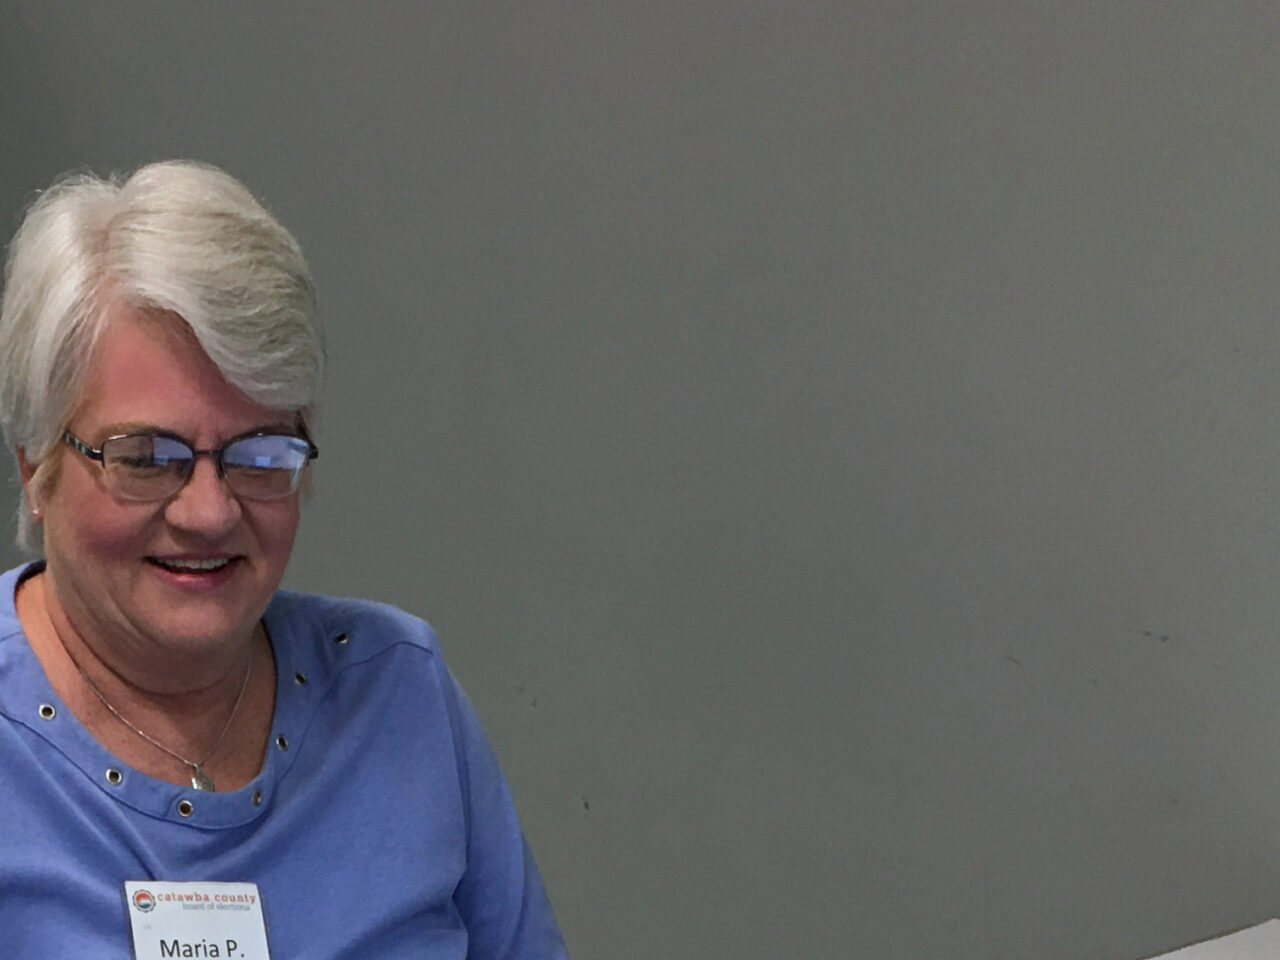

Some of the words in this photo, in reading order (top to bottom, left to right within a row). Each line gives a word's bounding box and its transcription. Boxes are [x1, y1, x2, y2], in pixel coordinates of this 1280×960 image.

[157, 891, 210, 902] catawba
[214, 893, 257, 905] county
[182, 902, 205, 911] board
[207, 902, 215, 911] of
[216, 902, 251, 912] elections
[159, 938, 220, 958] Maria
[226, 939, 245, 958] P.
